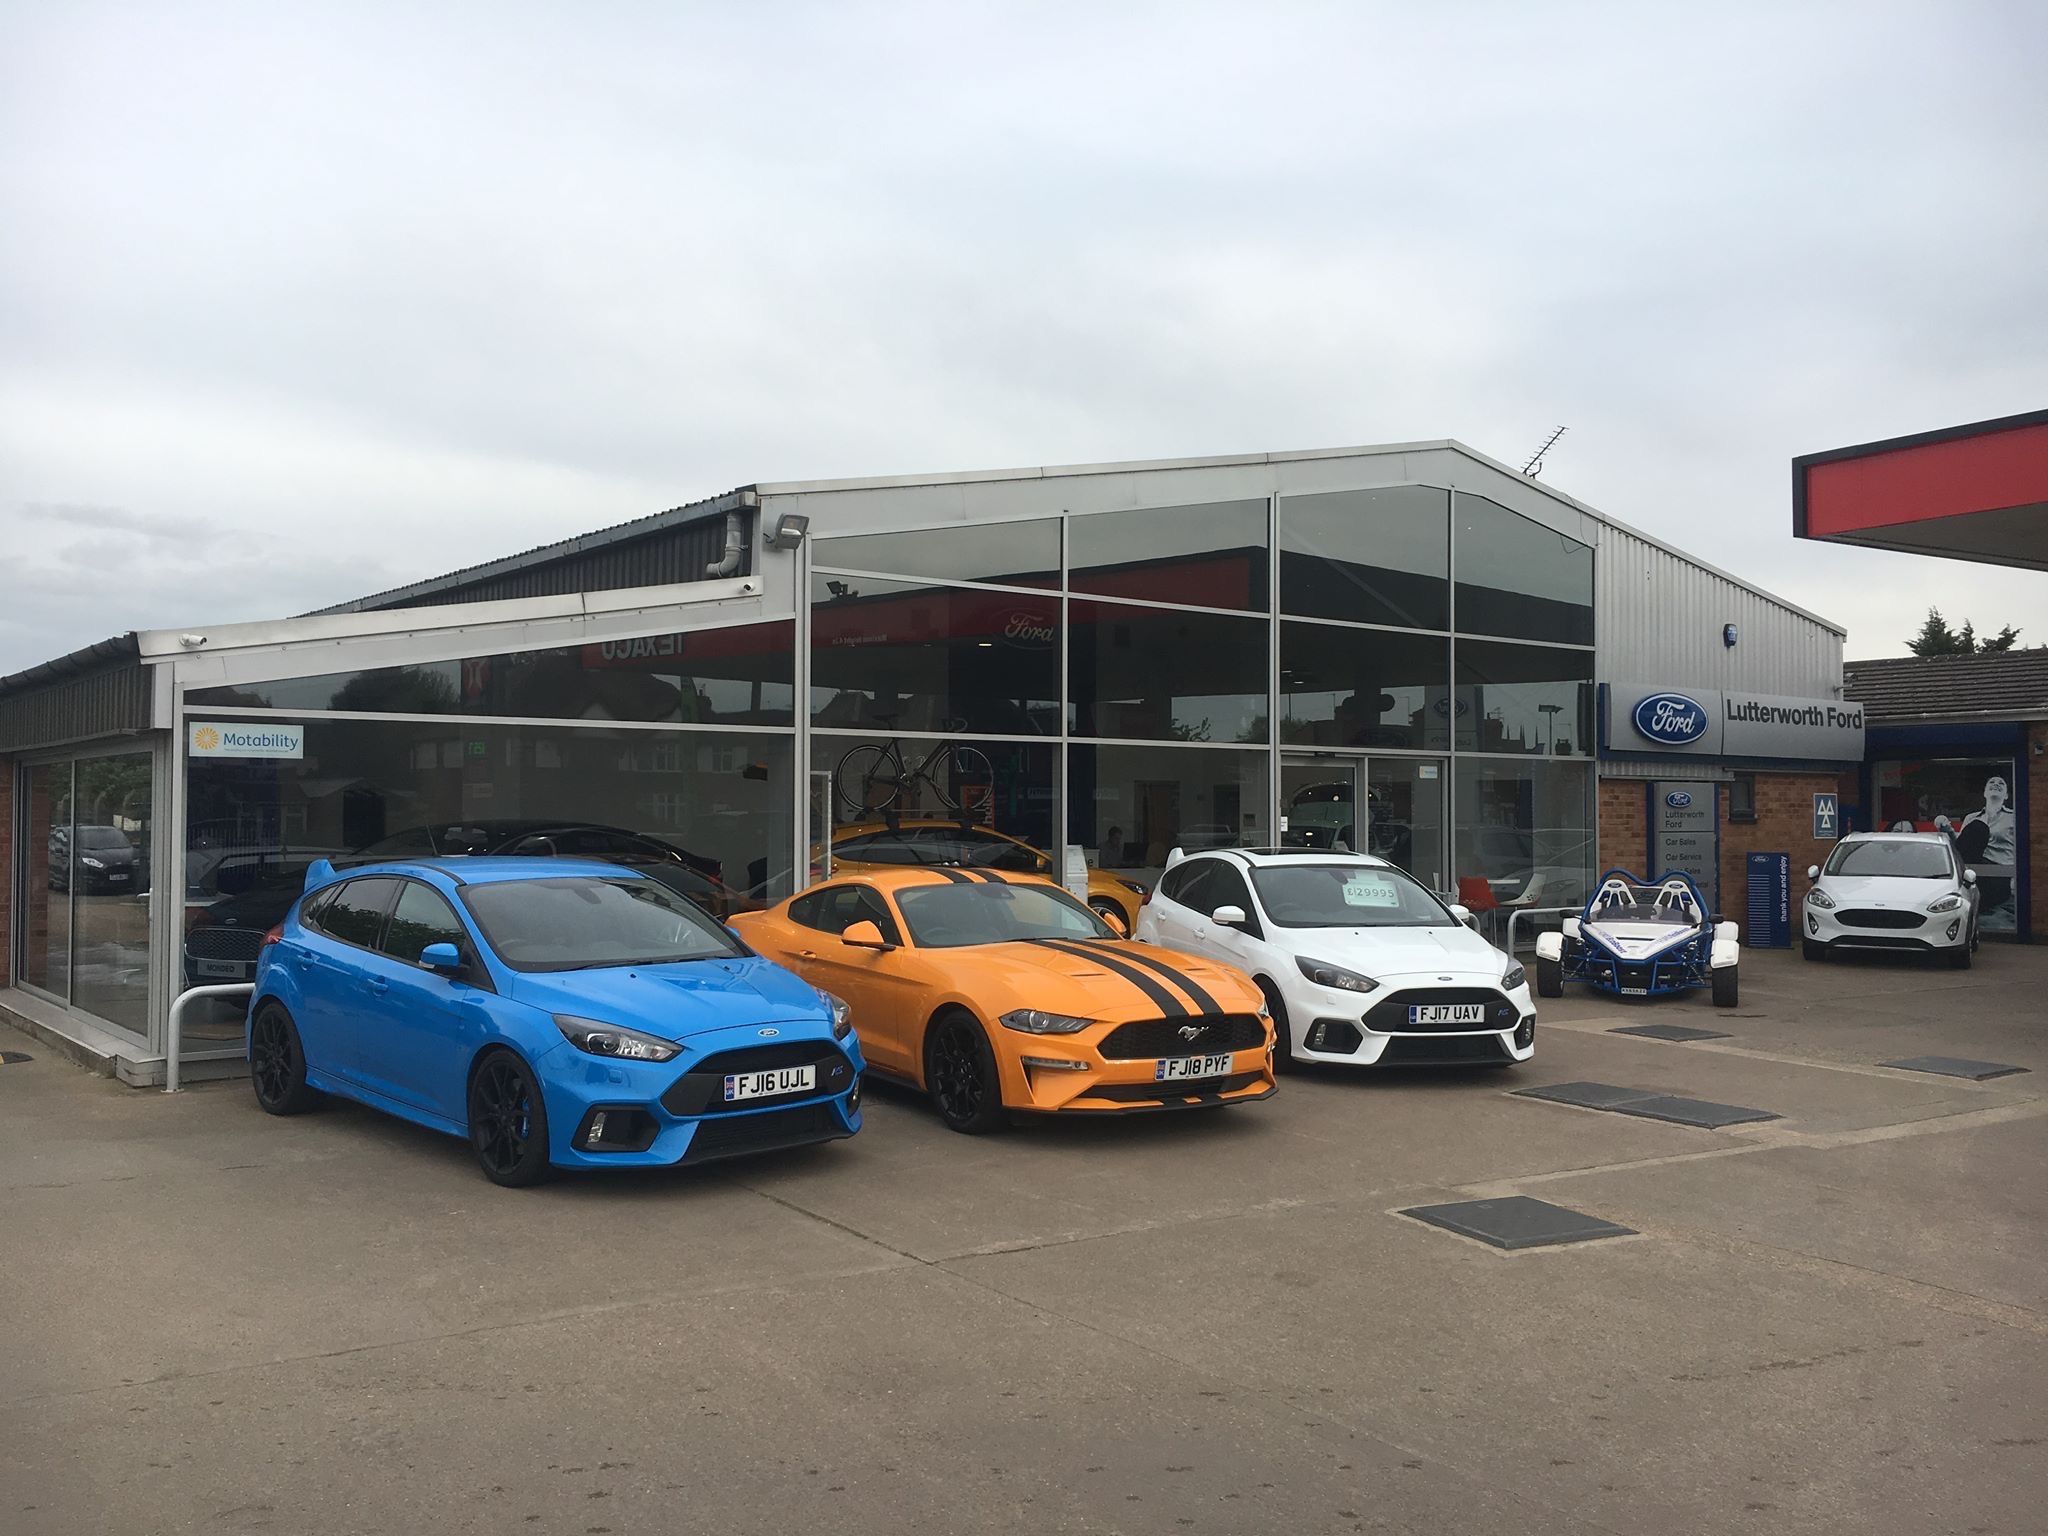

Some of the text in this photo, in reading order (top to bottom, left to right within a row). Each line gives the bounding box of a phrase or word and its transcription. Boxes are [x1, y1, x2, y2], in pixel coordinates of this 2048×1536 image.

[1651, 700, 1695, 734] Ford
[1727, 699, 1863, 729] Lutterworth Ford
[223, 733, 299, 751] Motability
[1665, 811, 1704, 819] Lutterworth
[1665, 838, 1696, 846] Car Sales
[1665, 853, 1702, 861] Car Service
[1779, 855, 1788, 874] enjoy
[1779, 874, 1787, 888] and
[1780, 902, 1788, 922] thank
[1420, 1006, 1480, 1021] FJ17 UAV
[1168, 1055, 1230, 1076] FJ18 PYF
[739, 1069, 810, 1096] FJ16 UJL
